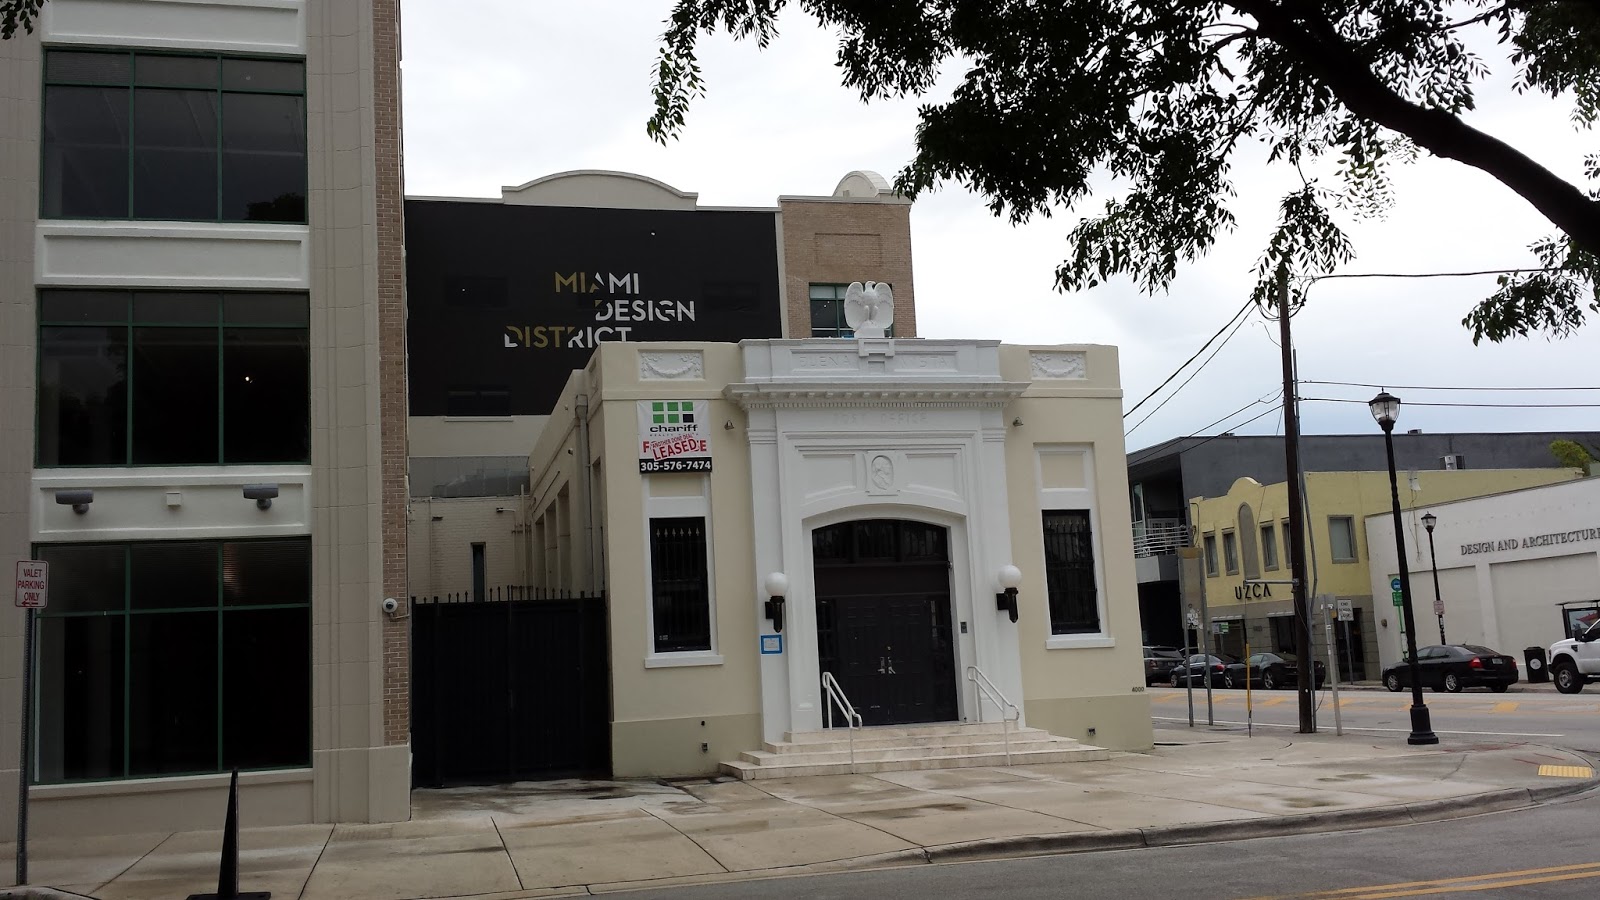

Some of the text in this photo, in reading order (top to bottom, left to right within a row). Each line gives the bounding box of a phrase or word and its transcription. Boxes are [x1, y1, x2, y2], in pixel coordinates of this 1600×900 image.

[554, 271, 640, 294] MIAMI
[594, 300, 696, 322] DESIGN
[504, 325, 632, 348] DISTRICT
[649, 424, 698, 433] chariff
[652, 438, 697, 460] LEASED
[640, 461, 711, 471] 305-576-7474
[1460, 541, 1495, 555] DESIGN
[1497, 539, 1519, 551] AND
[23, 568, 43, 577] VALET
[17, 580, 45, 589] PARKING
[1235, 583, 1272, 600] UZCA
[23, 592, 40, 601] ONLY
